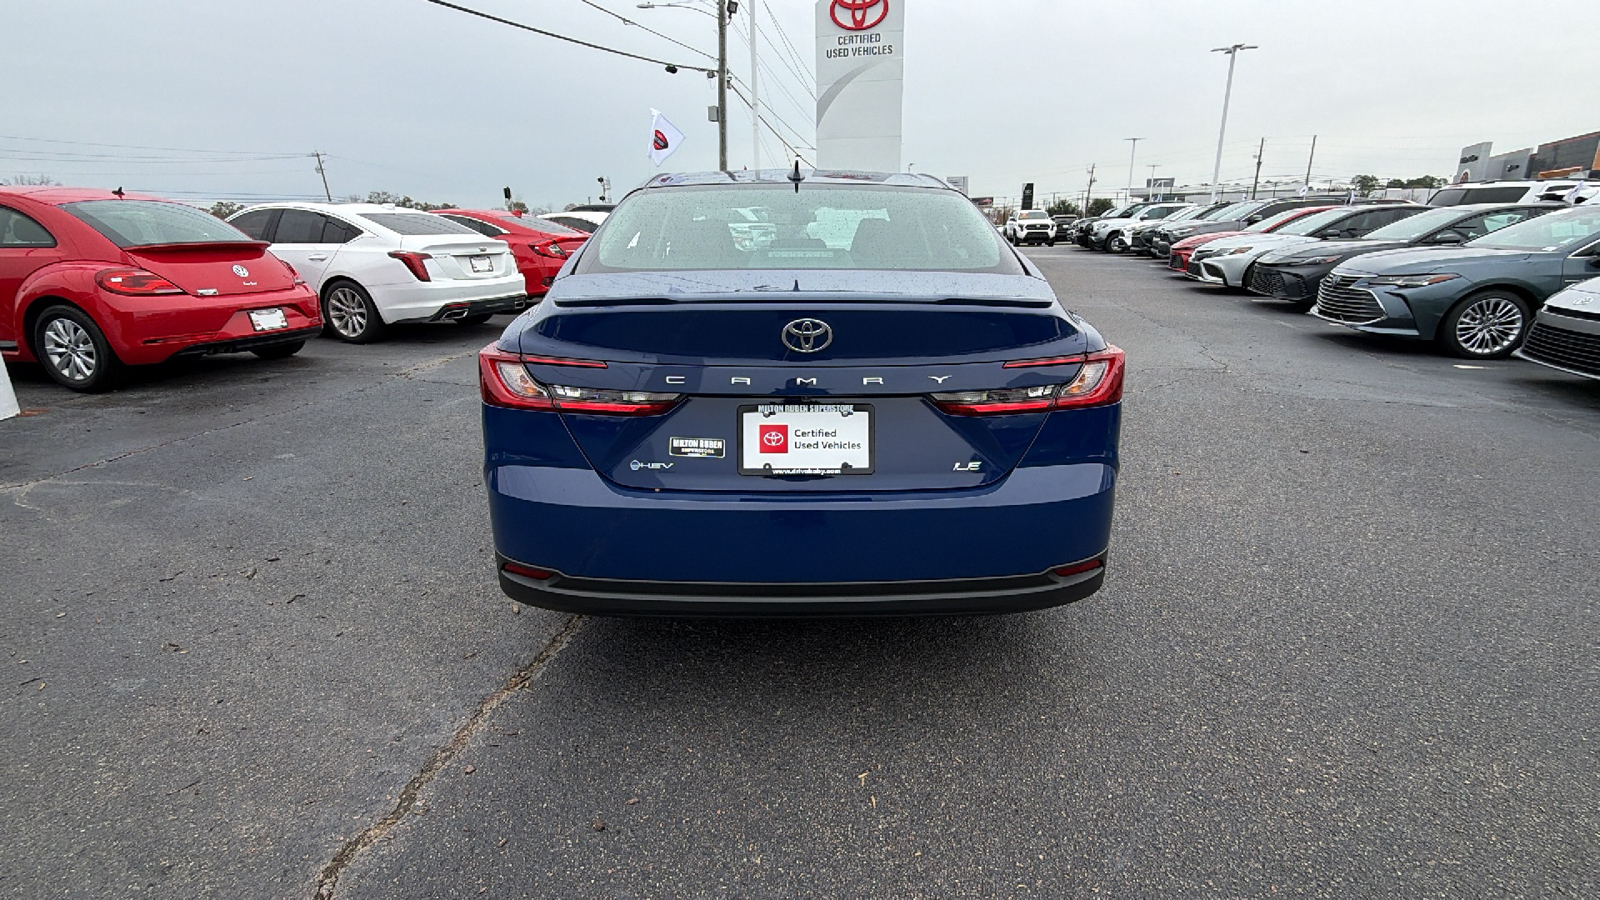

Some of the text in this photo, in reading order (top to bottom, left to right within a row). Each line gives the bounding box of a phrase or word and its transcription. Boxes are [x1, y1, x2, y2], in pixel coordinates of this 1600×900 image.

[838, 33, 881, 45] CERTIFIED
[826, 45, 893, 58] USED VEHICLES
[665, 375, 952, 386] CAMRY
[758, 404, 854, 413] MILTON RUBEN SUPERSTORE
[794, 428, 837, 437] Certified
[673, 438, 699, 448] MILTON
[794, 441, 862, 449] Used Vehicles
[952, 461, 982, 471] LE
